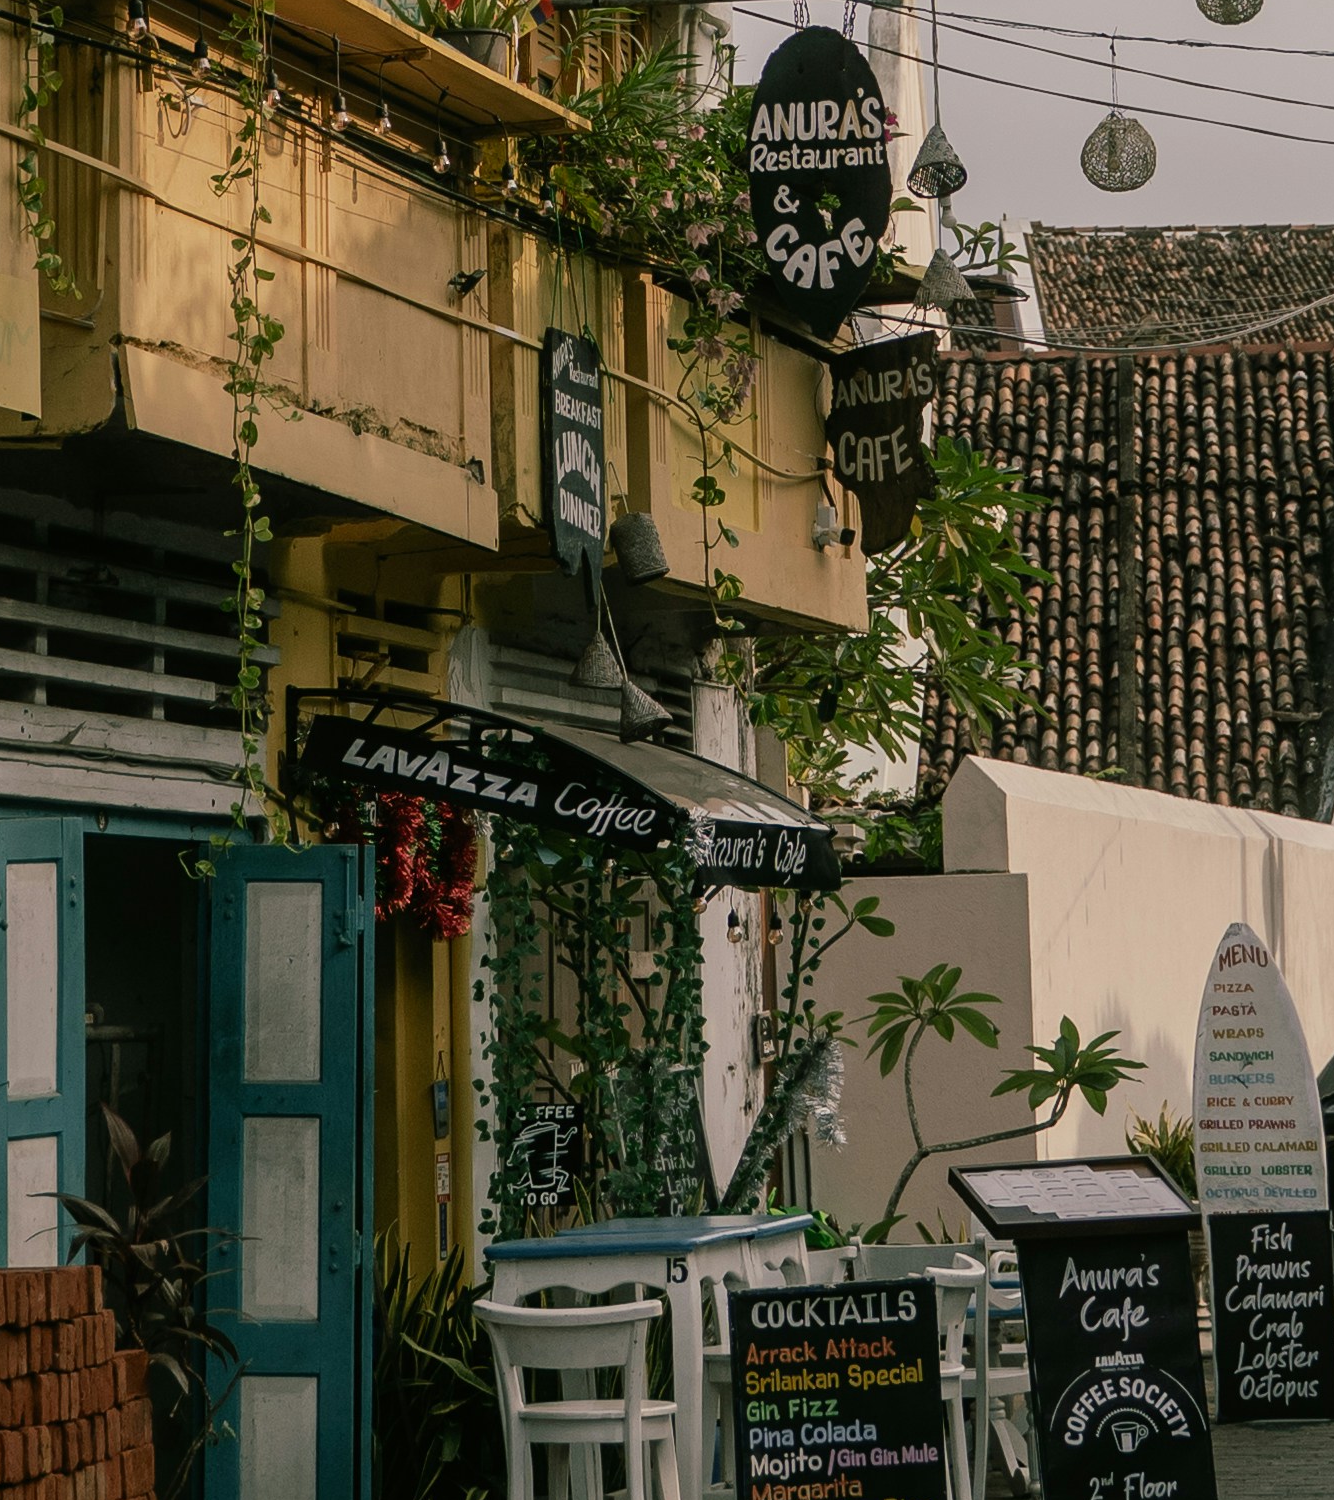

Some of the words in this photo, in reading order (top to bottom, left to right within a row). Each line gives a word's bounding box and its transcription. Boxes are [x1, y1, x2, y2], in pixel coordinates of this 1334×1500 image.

[750, 87, 883, 142] ANURA'S
[749, 140, 885, 174] Restaurant
[773, 185, 799, 213] &
[765, 217, 875, 289] CAFE
[552, 335, 574, 381] ANURA'S
[569, 362, 598, 390] Restaurant
[836, 355, 934, 409] ANURA'S
[555, 389, 602, 430] BREAKFAST
[555, 430, 601, 507] LUNCH
[838, 425, 914, 483] CAFE
[559, 487, 601, 541] DINNER
[342, 738, 538, 807] LAVAZZA
[554, 782, 657, 837] Coffee
[704, 824, 766, 869] Anura's
[774, 829, 806, 885] Cafe
[1218, 943, 1269, 972] MENU
[1213, 983, 1255, 993] PIZZA
[1212, 1027, 1265, 1039] WRAPS
[1209, 1050, 1274, 1062] SANDWICH
[1209, 1073, 1275, 1085] BURGERS
[516, 1105, 575, 1121] CFFEE
[1207, 1097, 1236, 1107] RICE
[1242, 1097, 1250, 1107] &
[1254, 1096, 1295, 1106] CURRY
[1199, 1119, 1244, 1130] GRILLED
[1248, 1119, 1296, 1129] PRAWNS
[1200, 1142, 1250, 1153] GRILLED
[1254, 1140, 1318, 1152] CALAMARI
[1204, 1165, 1251, 1176] GRILLED
[1261, 1164, 1313, 1176] LOBSTER
[540, 1192, 558, 1205] GO
[1205, 1187, 1259, 1198] OCTOPUS
[1264, 1187, 1317, 1198] DEVILLED
[1251, 1222, 1293, 1253] Fish
[666, 1257, 689, 1283] 15
[1059, 1253, 1160, 1299] Anura's
[1236, 1254, 1312, 1284] Prawns
[751, 1290, 917, 1330] COCKTAILS
[1225, 1282, 1325, 1312] Calamari
[1080, 1296, 1150, 1342] Cafe
[1249, 1310, 1304, 1341] Crab
[746, 1341, 817, 1366] Arrack
[825, 1336, 896, 1361] Attack
[1095, 1351, 1145, 1368] LAVAZZA
[1234, 1339, 1319, 1375] Lobster
[745, 1368, 840, 1395] Srilankan
[847, 1358, 924, 1390] Special
[1239, 1369, 1319, 1406] Octopus
[746, 1401, 781, 1423] Gin
[1063, 1379, 1118, 1446] COFFEE
[1119, 1376, 1191, 1438] SOCIETY
[749, 1427, 794, 1450] Pina
[800, 1419, 877, 1446] Colada
[750, 1447, 823, 1480] Mojito
[870, 1448, 899, 1466] Gin
[901, 1443, 939, 1464] Mule
